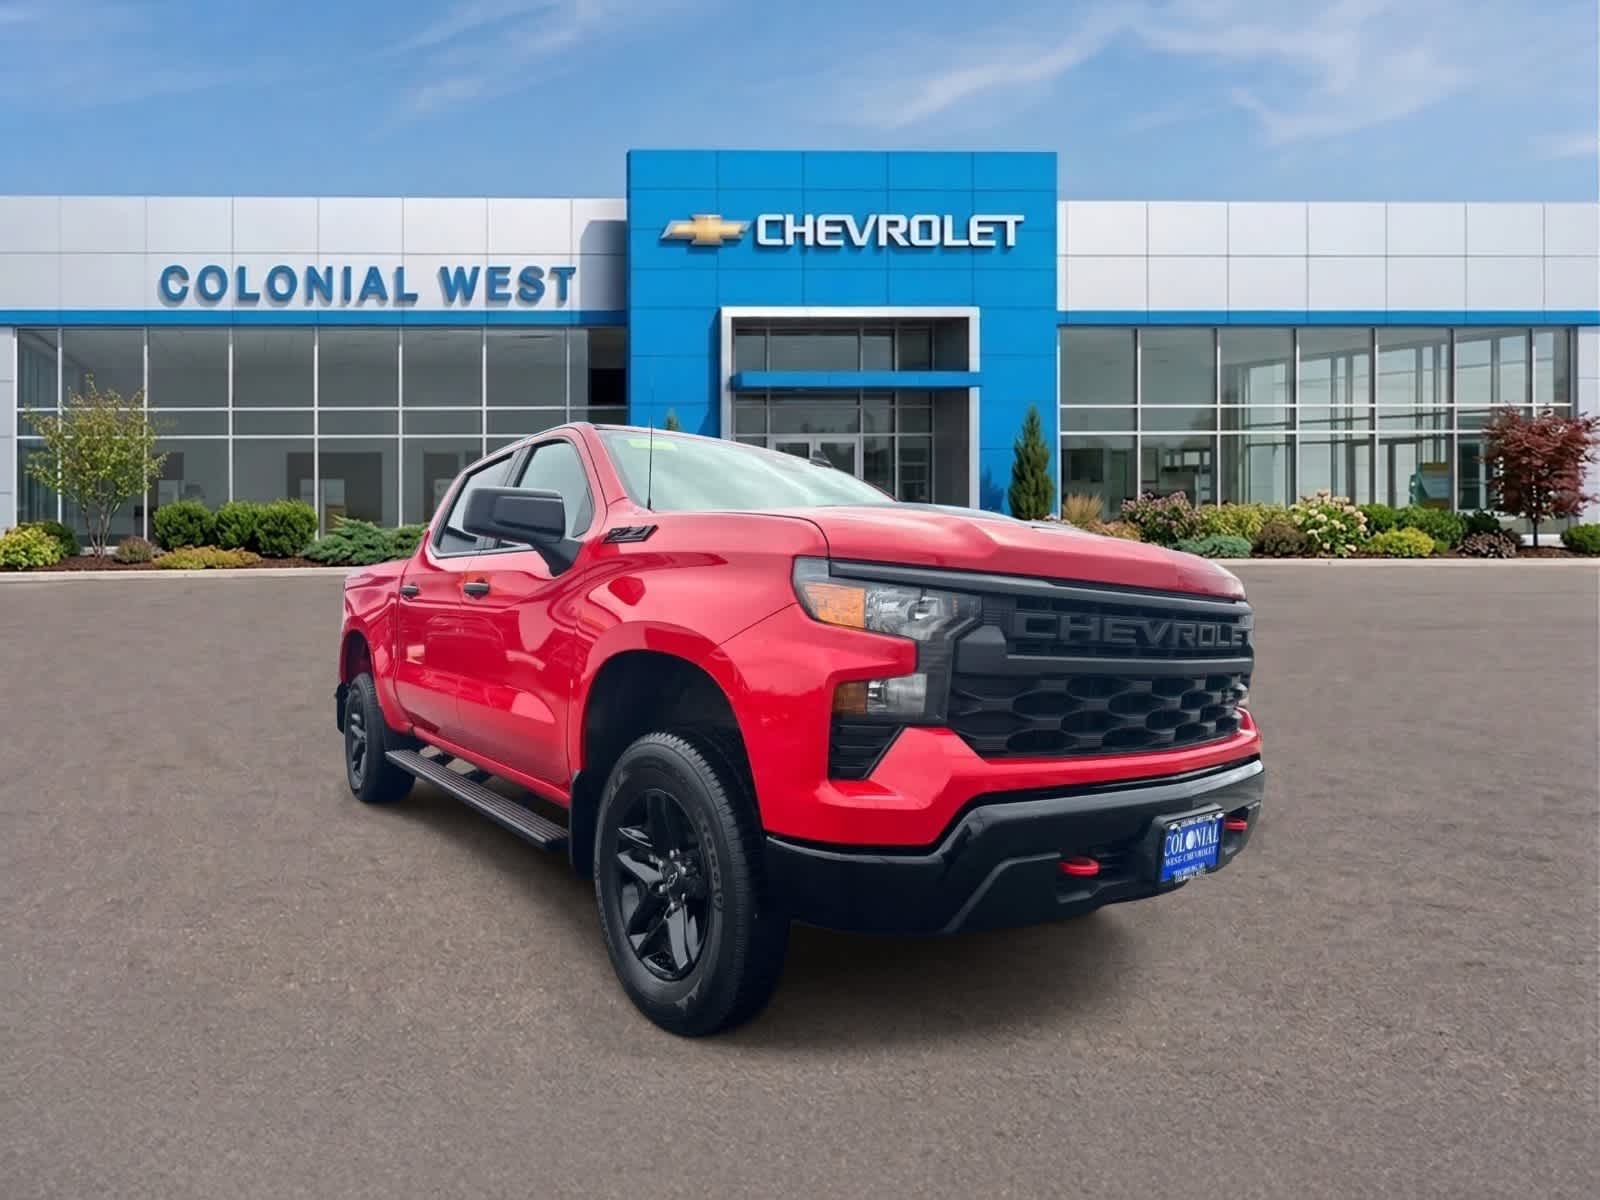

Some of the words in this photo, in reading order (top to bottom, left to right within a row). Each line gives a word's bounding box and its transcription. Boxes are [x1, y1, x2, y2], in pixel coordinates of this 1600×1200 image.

[757, 213, 1025, 247] CHEVROLET
[159, 264, 418, 305] COLONIAL
[437, 265, 577, 304] WEST
[1164, 824, 1219, 857] COLONIAL
